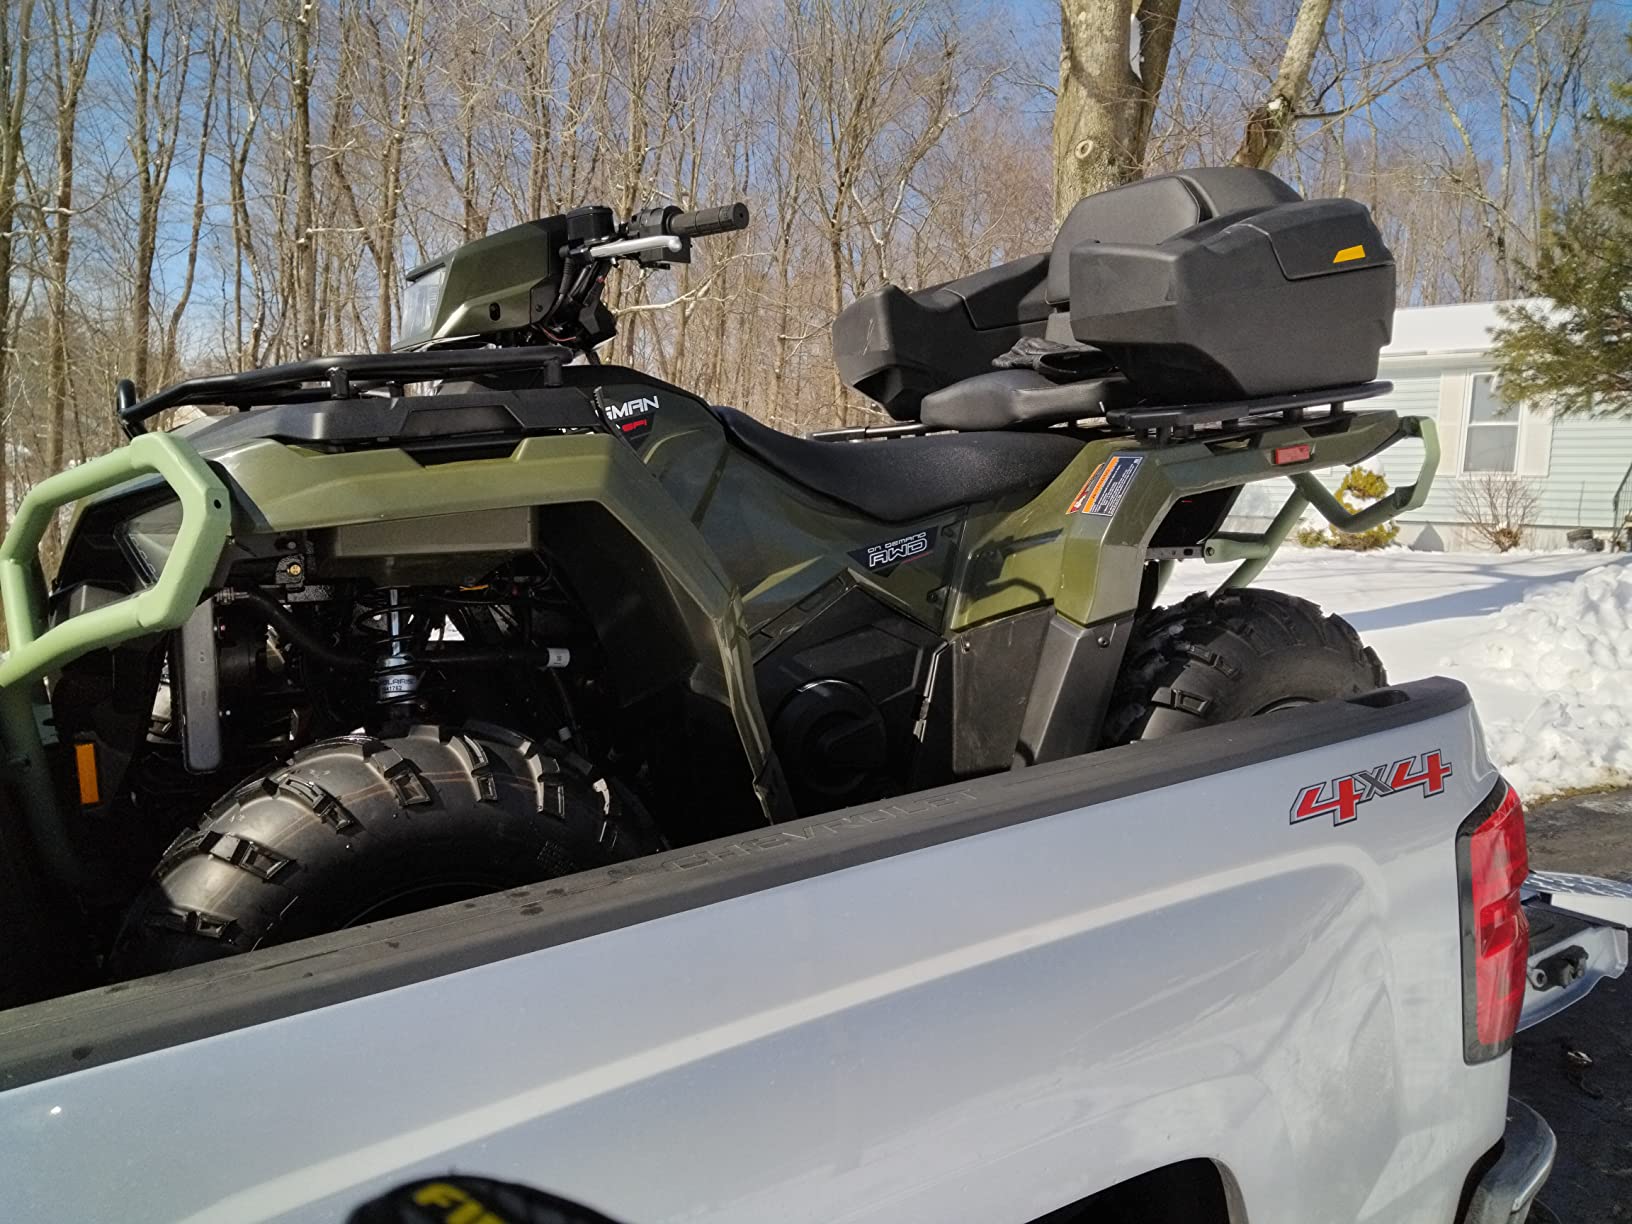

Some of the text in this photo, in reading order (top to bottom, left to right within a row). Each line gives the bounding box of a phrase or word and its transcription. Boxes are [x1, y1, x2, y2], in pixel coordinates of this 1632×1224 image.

[867, 532, 927, 554] ON DEMAND
[869, 538, 928, 567] AWD
[660, 788, 977, 872] CHEVROLET
